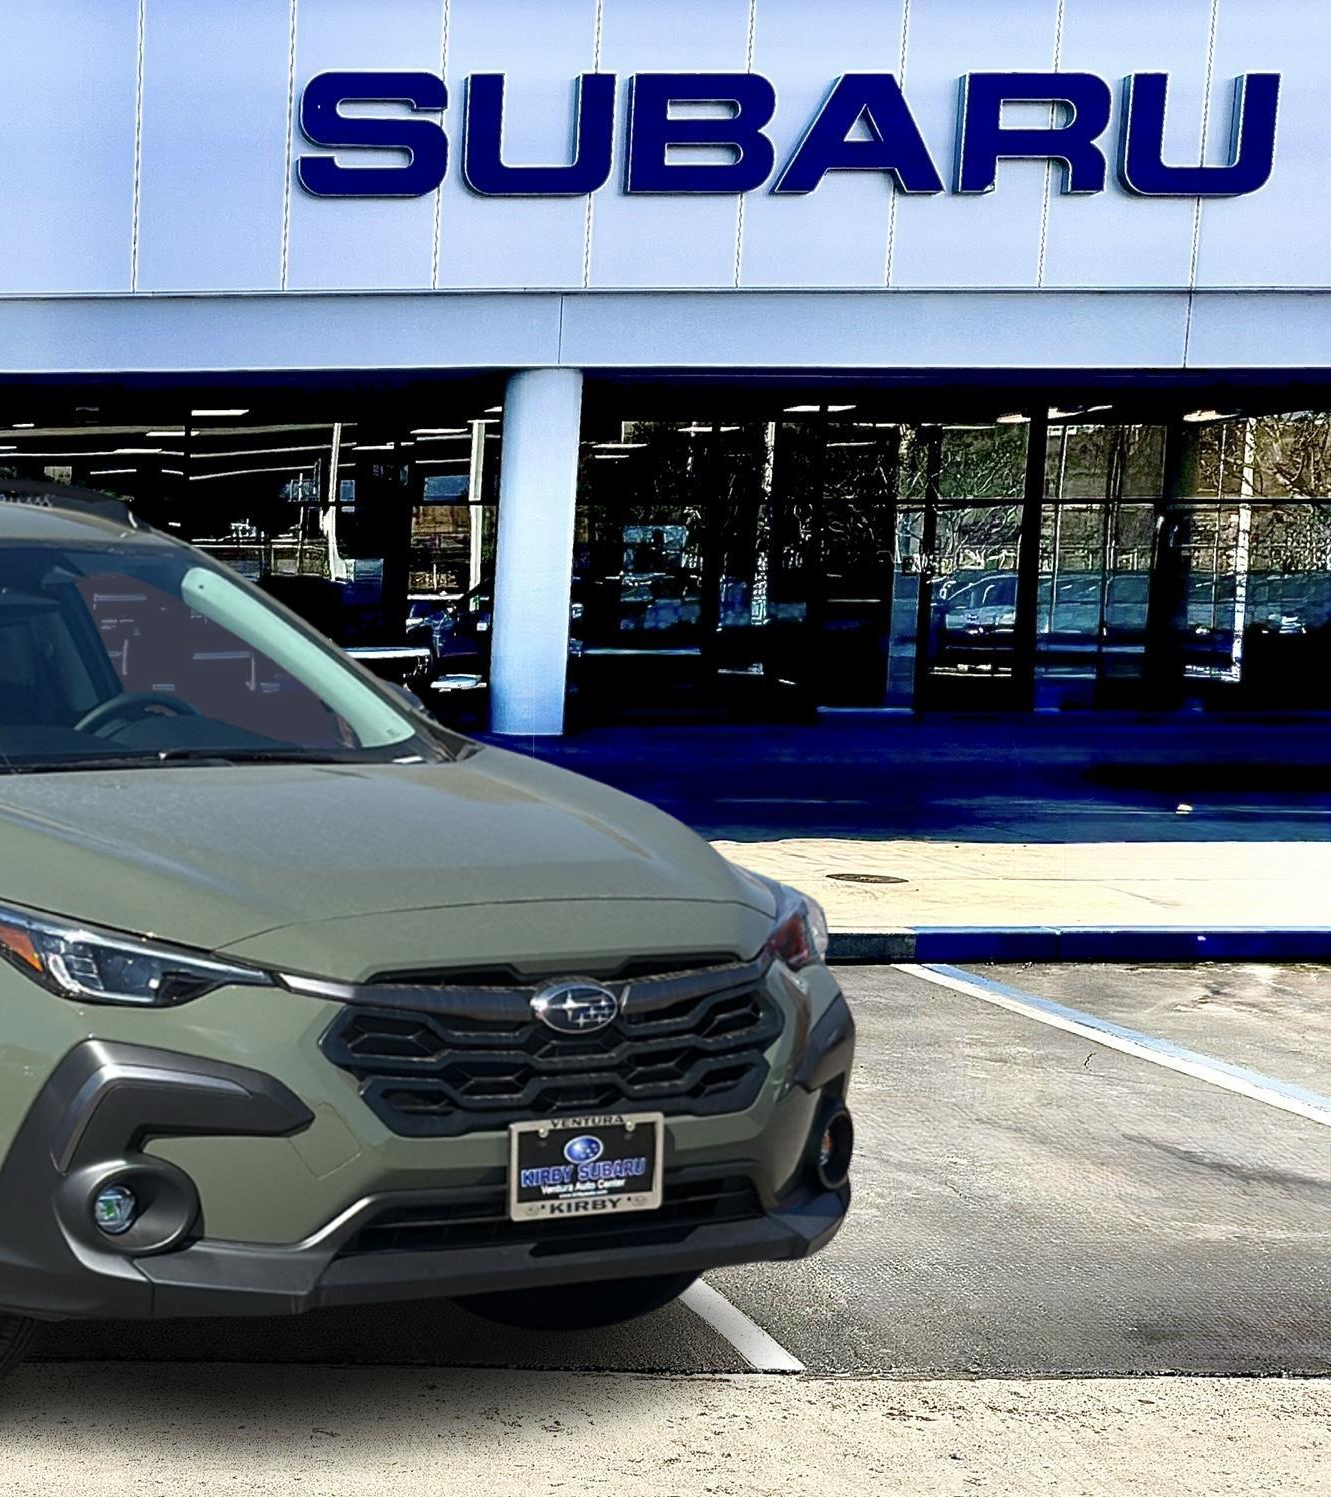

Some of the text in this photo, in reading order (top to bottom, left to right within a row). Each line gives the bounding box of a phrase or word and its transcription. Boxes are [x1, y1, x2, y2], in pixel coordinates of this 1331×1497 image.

[297, 71, 1283, 198] SUBARU
[551, 1115, 625, 1129] VENTURA
[521, 1157, 646, 1187] KIRBY SUBARU
[541, 1184, 574, 1196] Ventura
[575, 1181, 596, 1191] Auto
[597, 1179, 626, 1189] Center
[550, 1197, 621, 1214] KIRBY
